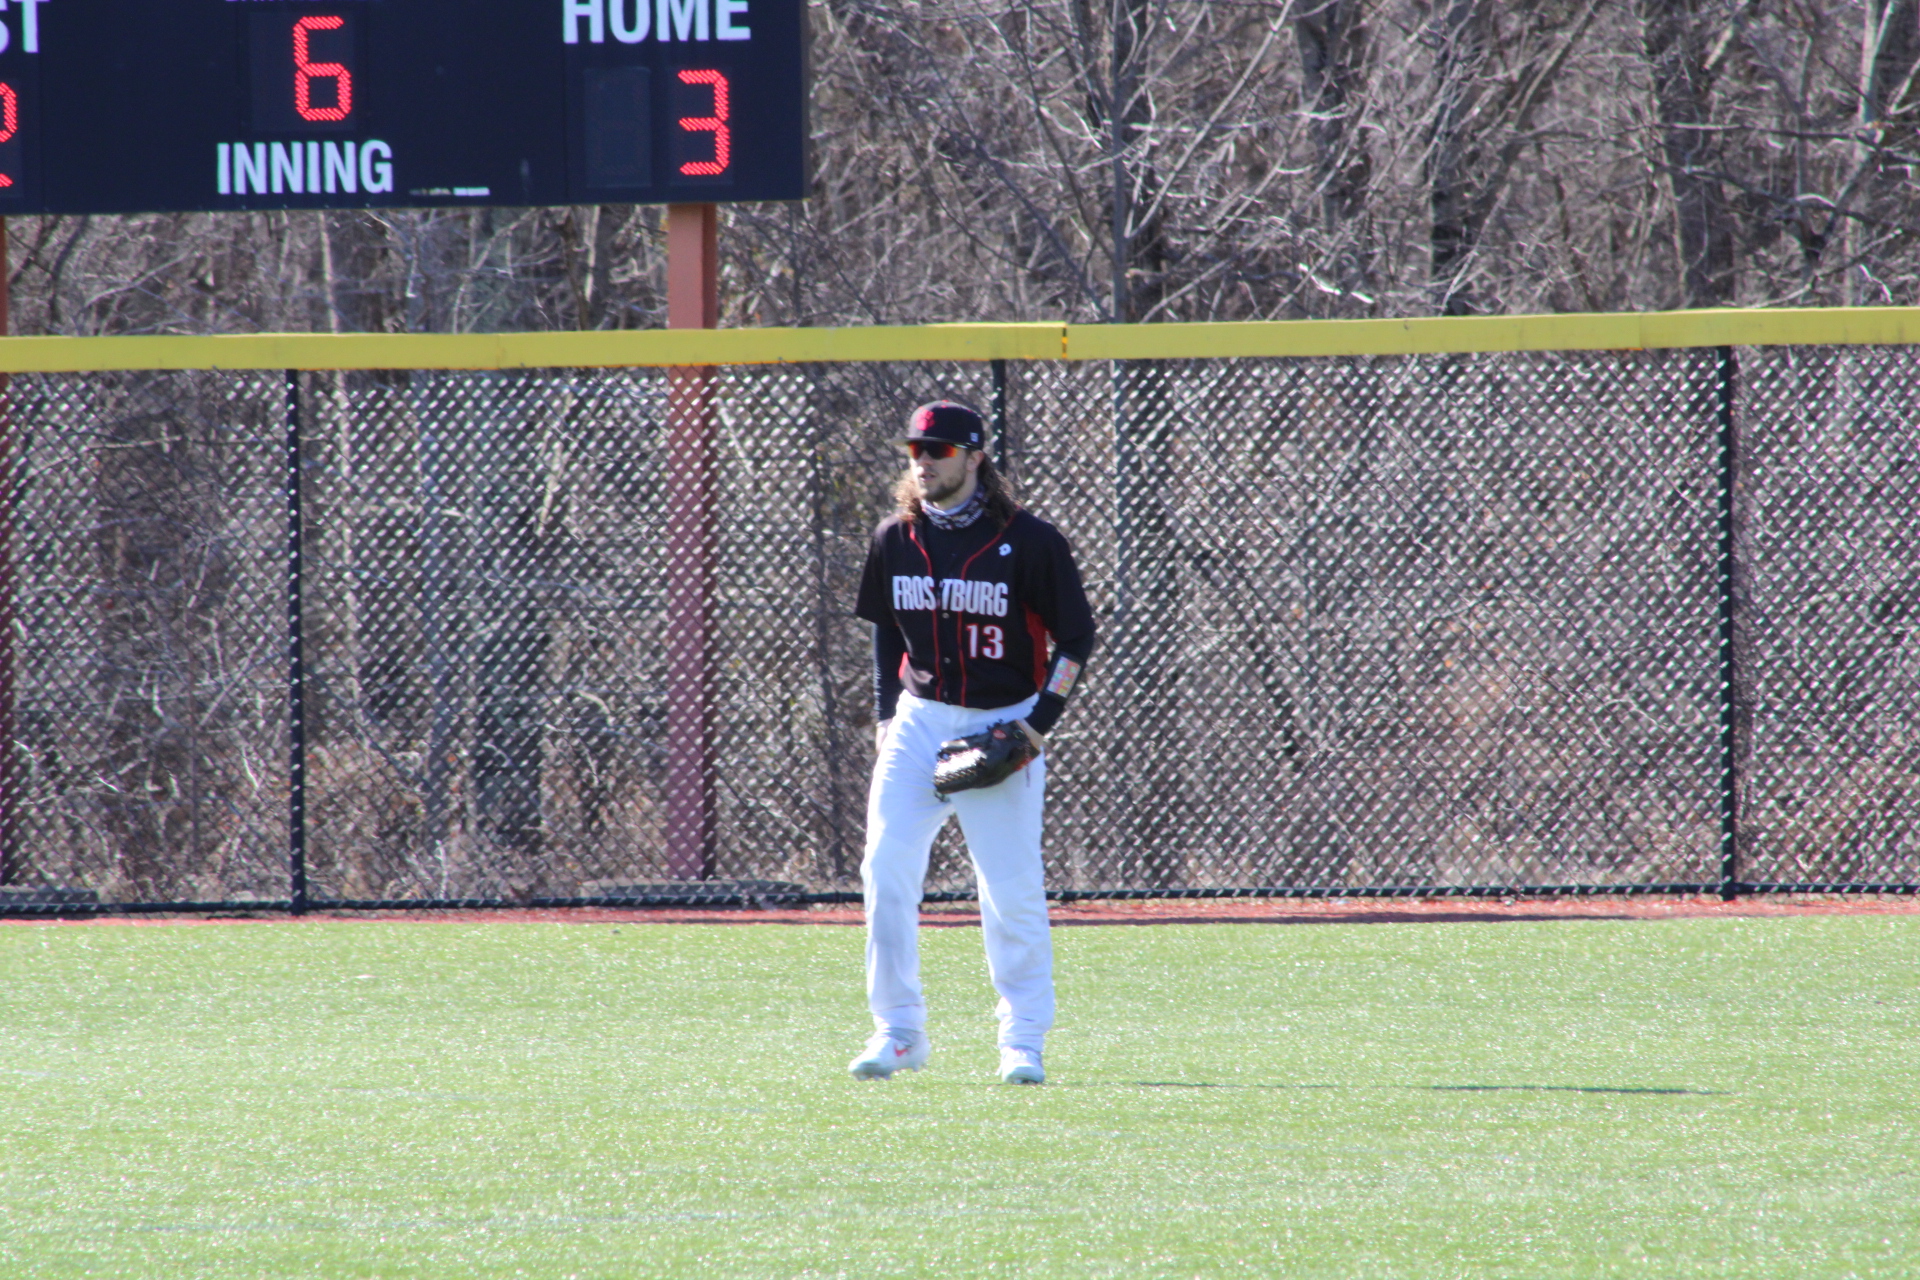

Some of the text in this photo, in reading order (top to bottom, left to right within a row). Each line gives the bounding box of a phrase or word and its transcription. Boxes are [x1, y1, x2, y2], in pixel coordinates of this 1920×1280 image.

[0, 0, 51, 53] T
[562, 0, 751, 43] HOME
[293, 16, 351, 121] 6
[678, 69, 730, 175] 3
[217, 140, 393, 194] INNING
[892, 575, 1009, 617] FROSTBURG
[966, 623, 1004, 660] 13
